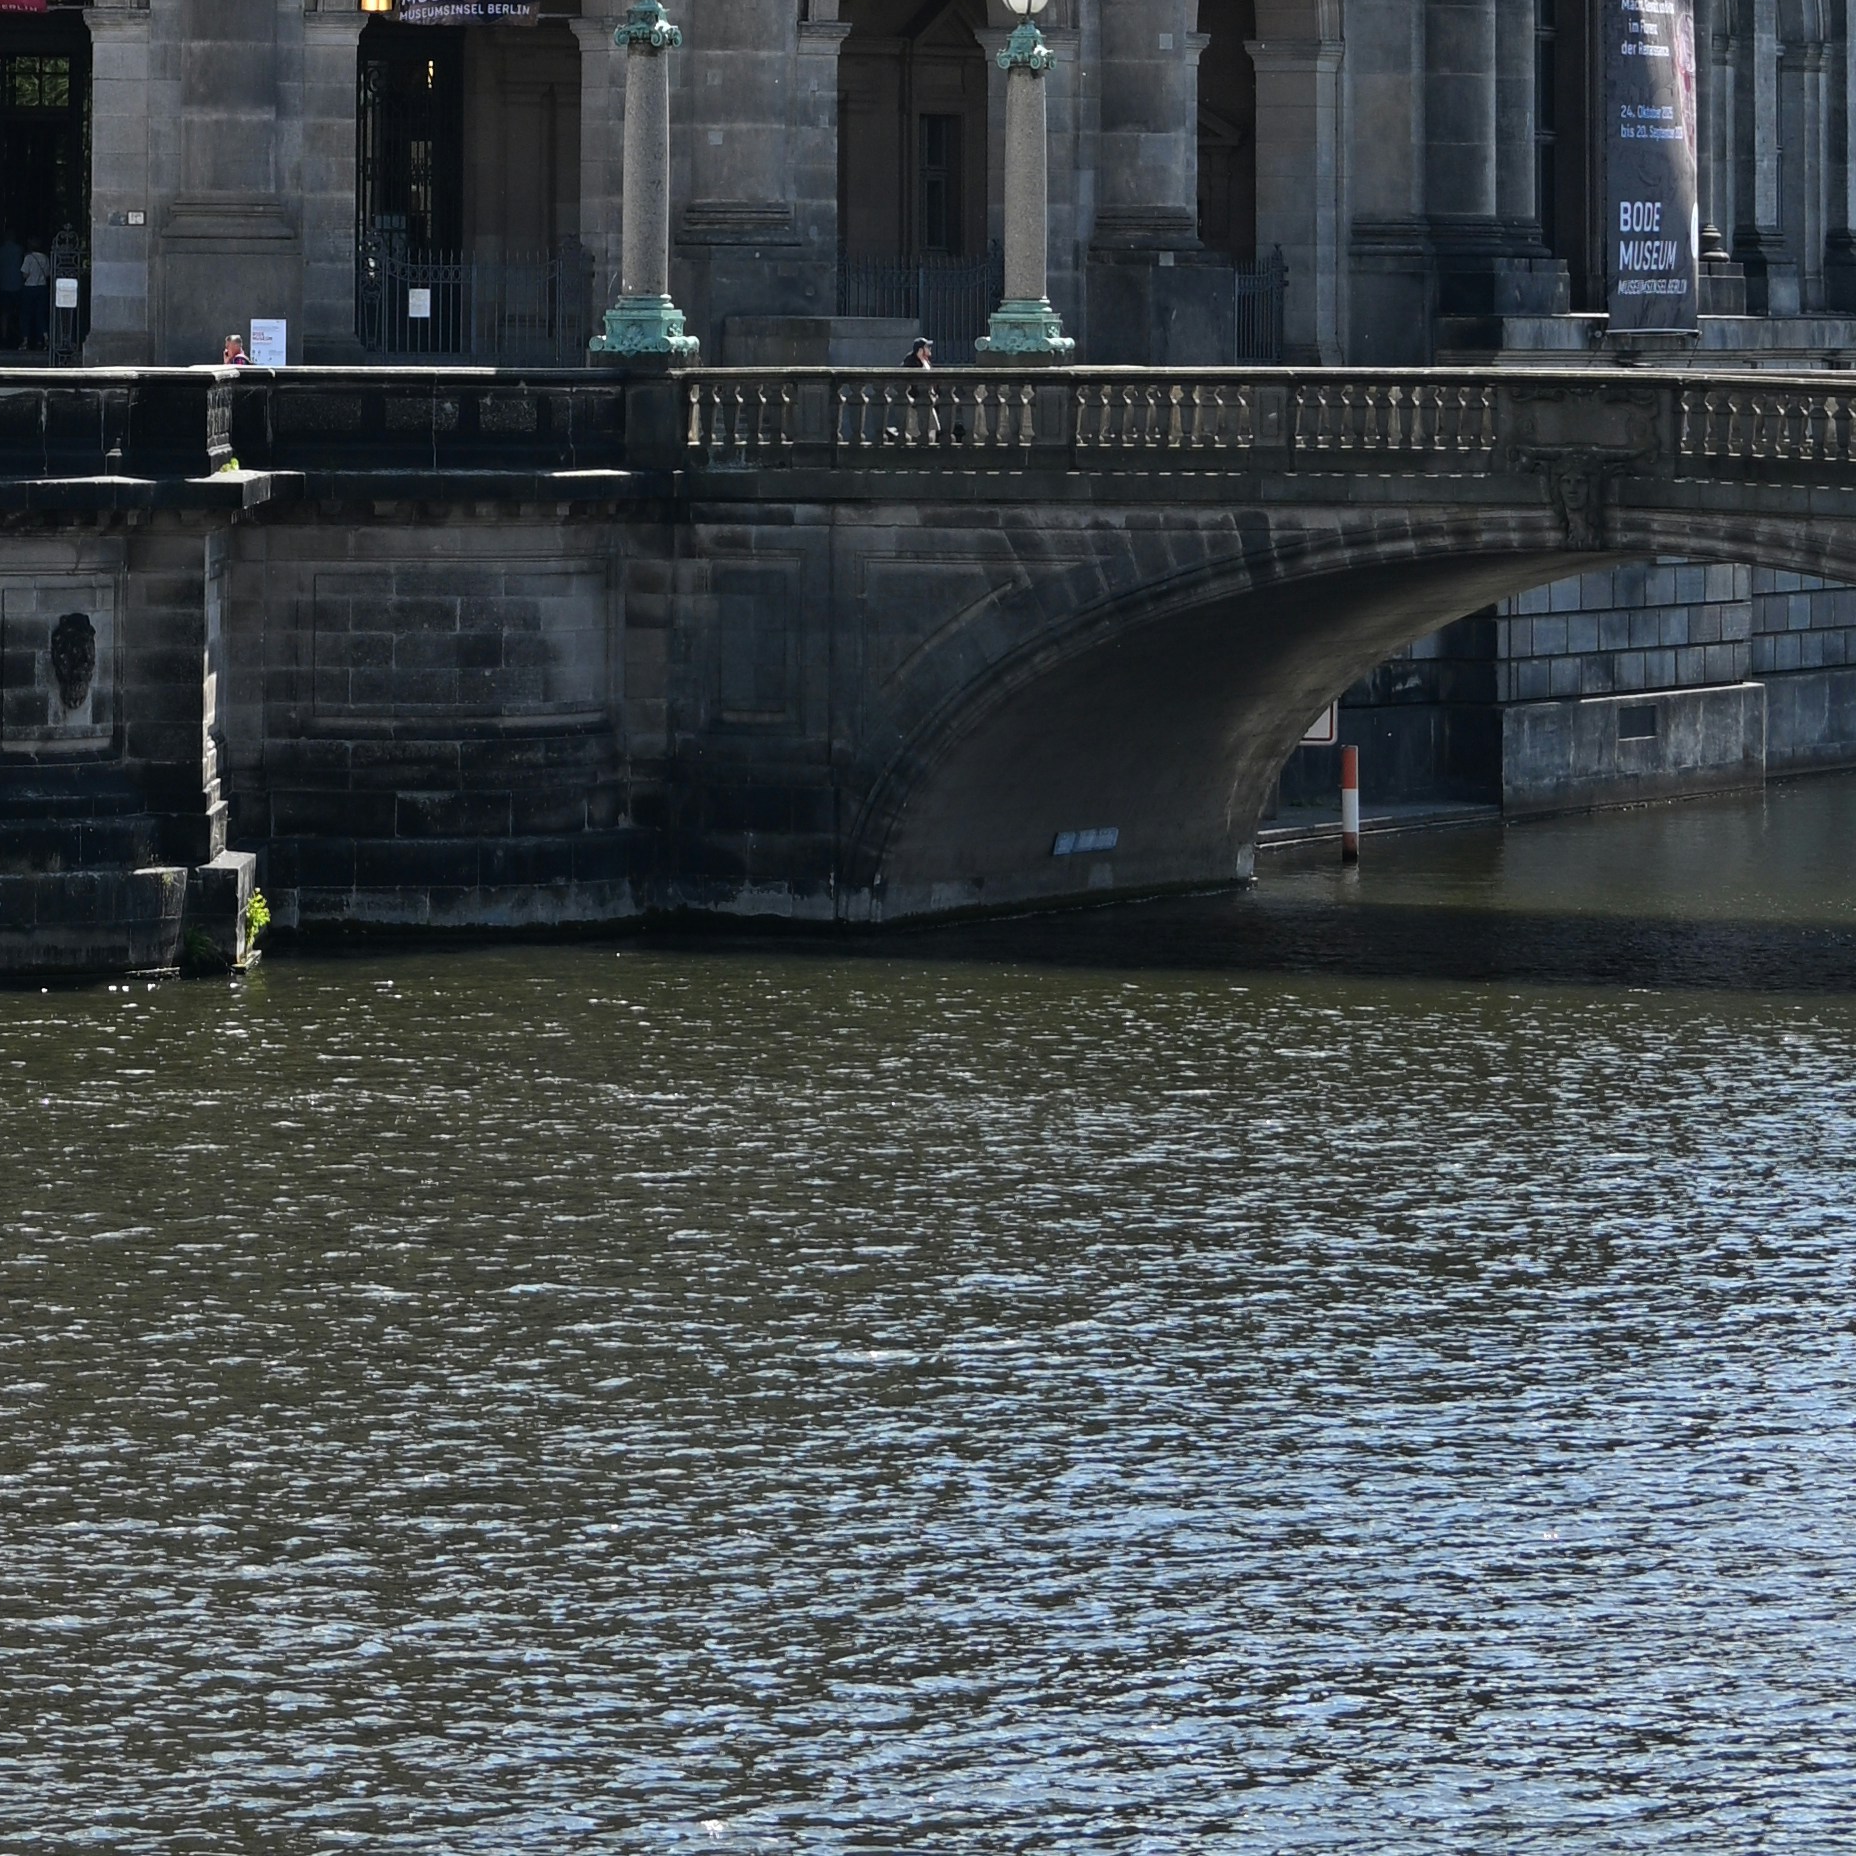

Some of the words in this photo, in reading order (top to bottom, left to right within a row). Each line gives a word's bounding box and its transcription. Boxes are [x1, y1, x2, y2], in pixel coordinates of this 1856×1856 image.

[399, 4, 484, 20] MUSEUMSINSEL
[487, 4, 530, 15] BERLIN
[1619, 201, 1662, 232] BODE
[1618, 240, 1677, 271] MUSEUM
